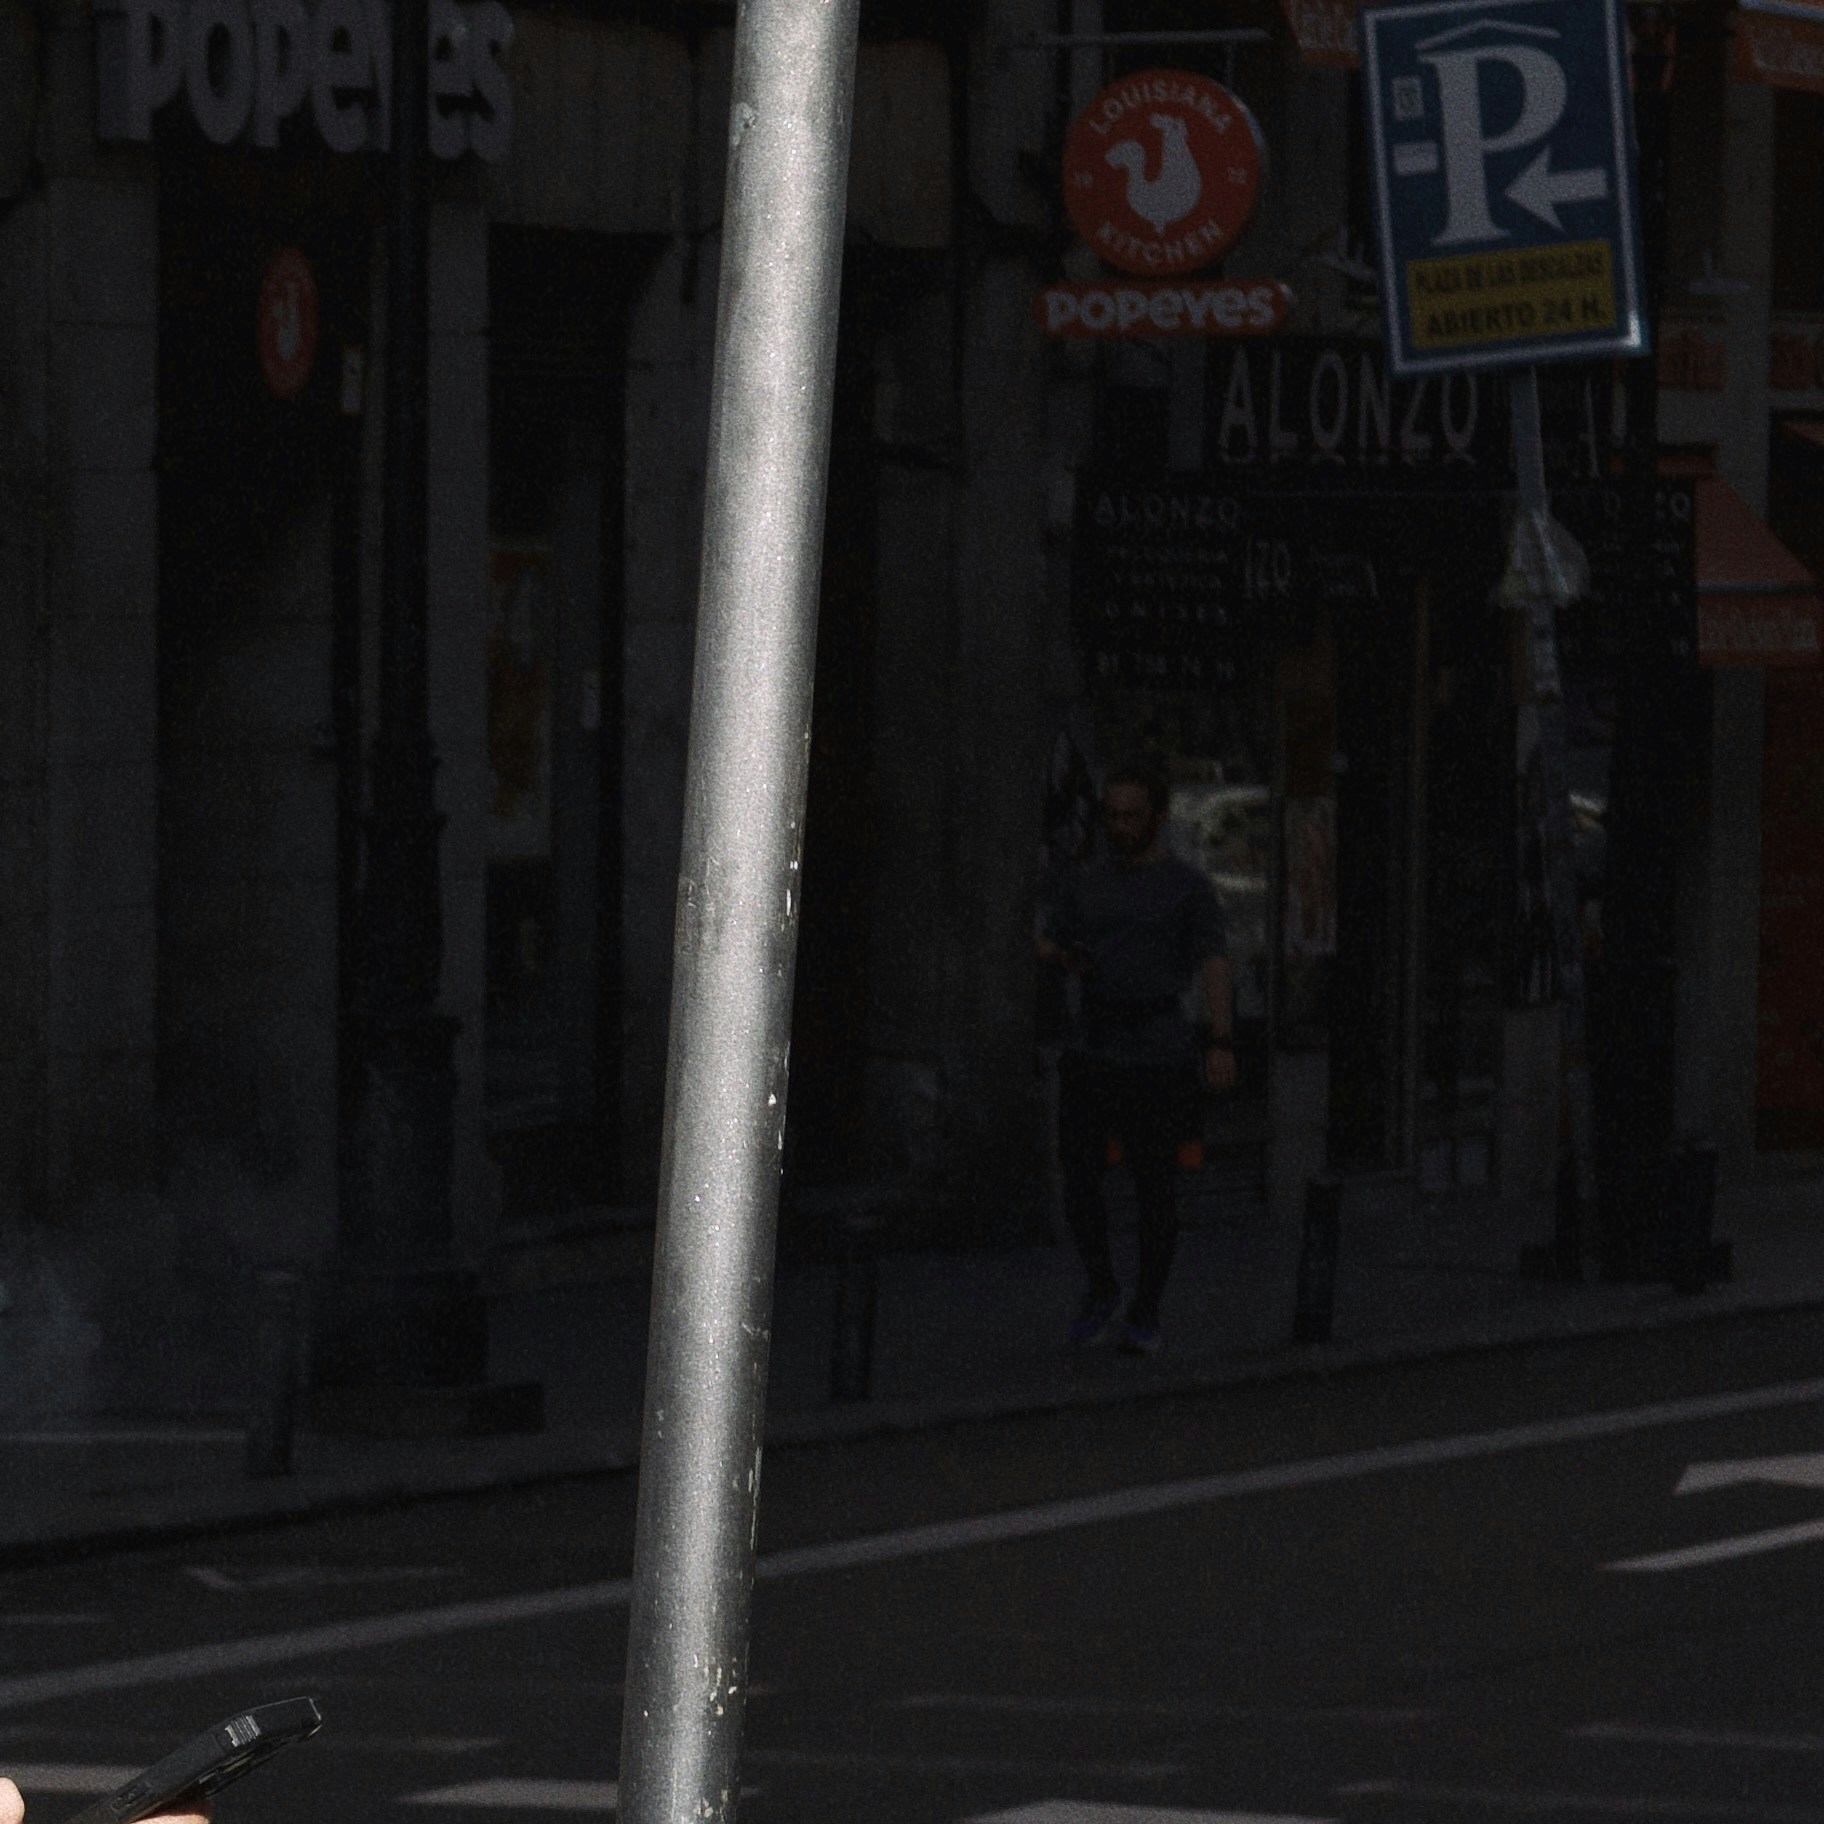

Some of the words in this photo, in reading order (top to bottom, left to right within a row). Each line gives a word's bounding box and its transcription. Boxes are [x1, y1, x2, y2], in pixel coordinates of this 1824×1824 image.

[1089, 79, 1234, 135] LOUISIANA
[1416, 44, 1567, 247] P
[1096, 217, 1224, 265] KITCHEN
[1426, 301, 1537, 338] ABIERTO
[1542, 297, 1573, 325] 24
[1218, 344, 1480, 450] ALONZO
